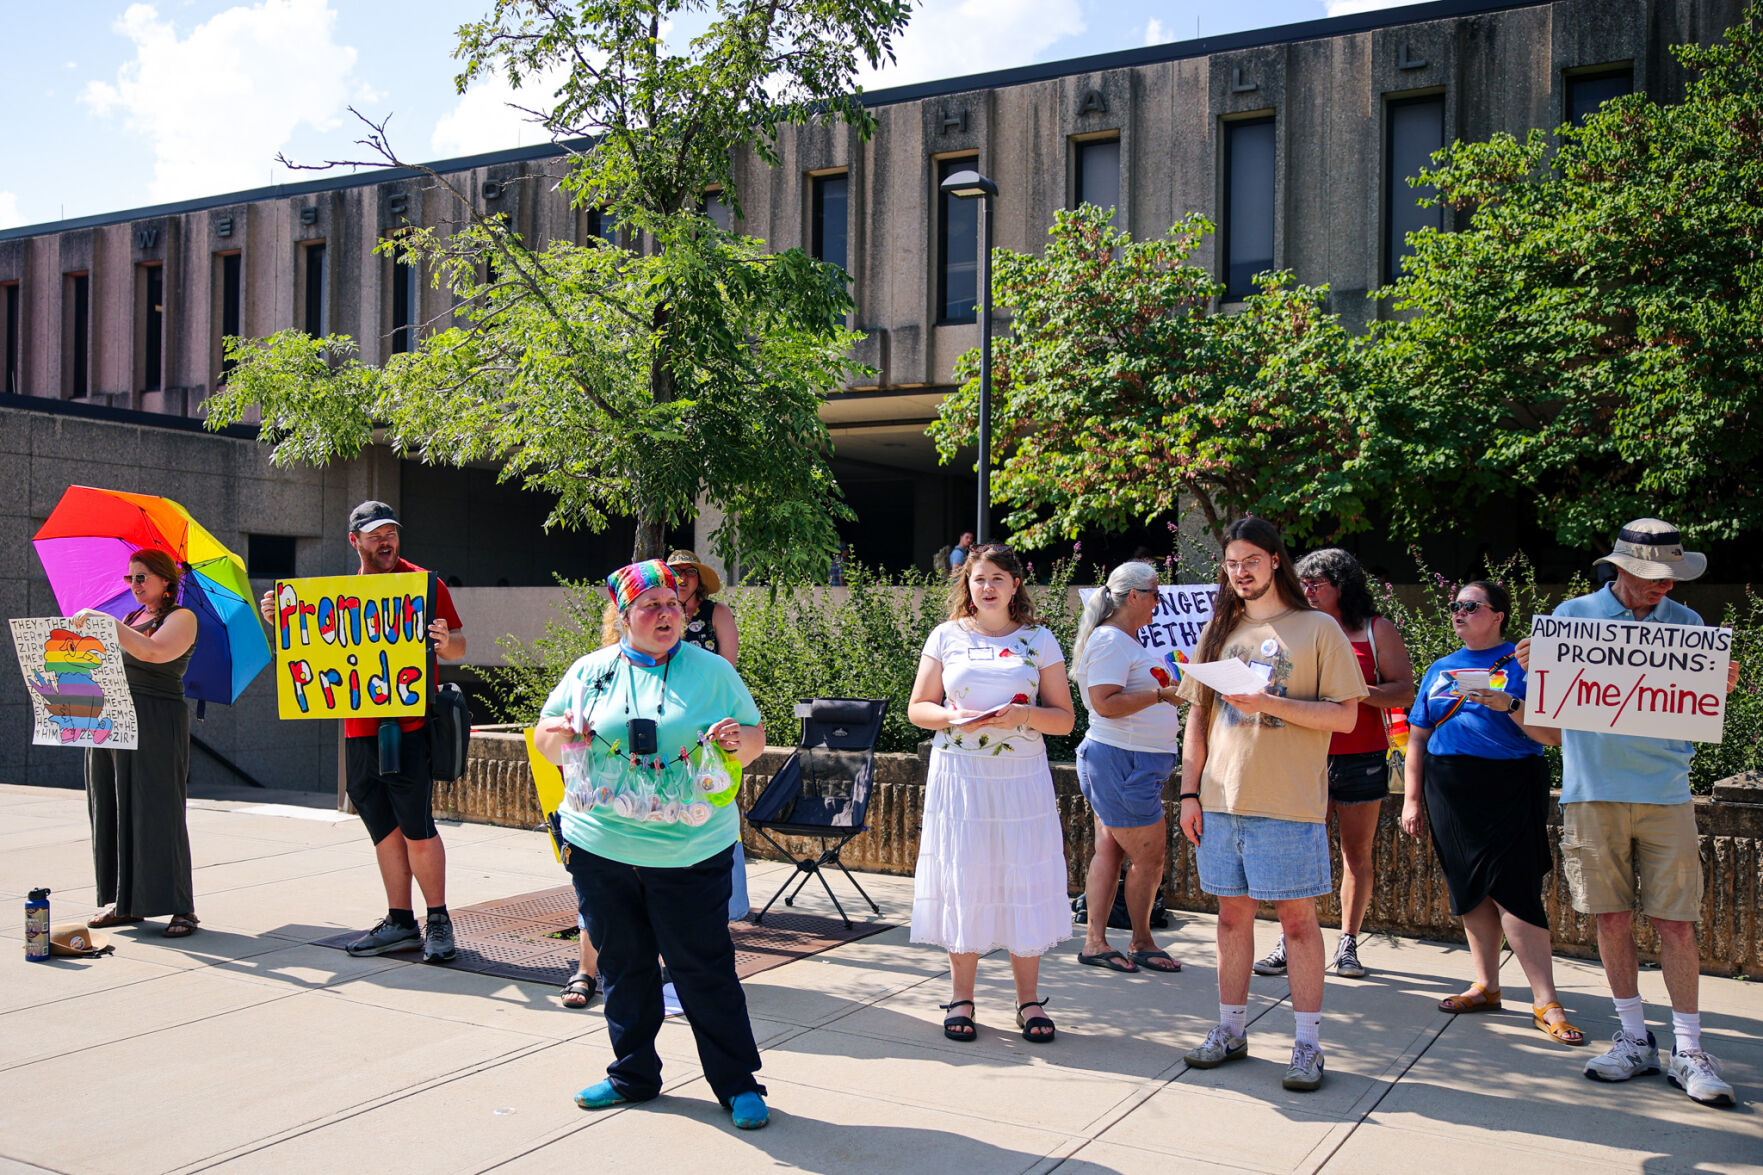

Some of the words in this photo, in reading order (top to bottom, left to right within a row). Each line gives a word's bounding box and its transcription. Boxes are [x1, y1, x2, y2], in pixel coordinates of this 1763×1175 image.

[936, 44, 1427, 135] HALL
[277, 582, 426, 650] Pronoun
[11, 620, 37, 629] THEY
[86, 618, 106, 630] SHE
[15, 631, 37, 641] HER
[1532, 617, 1731, 651] ADMINISTRATION'S
[18, 642, 38, 653] ZIR
[25, 653, 38, 663] ME
[1557, 642, 1716, 673] PRONOUNS:
[92, 666, 110, 676] SHE
[104, 697, 118, 708] ME
[36, 717, 49, 728] HE
[124, 720, 137, 732] HE
[41, 729, 59, 740] HIM
[79, 730, 93, 740] ZE
[112, 731, 130, 743] ZIR
